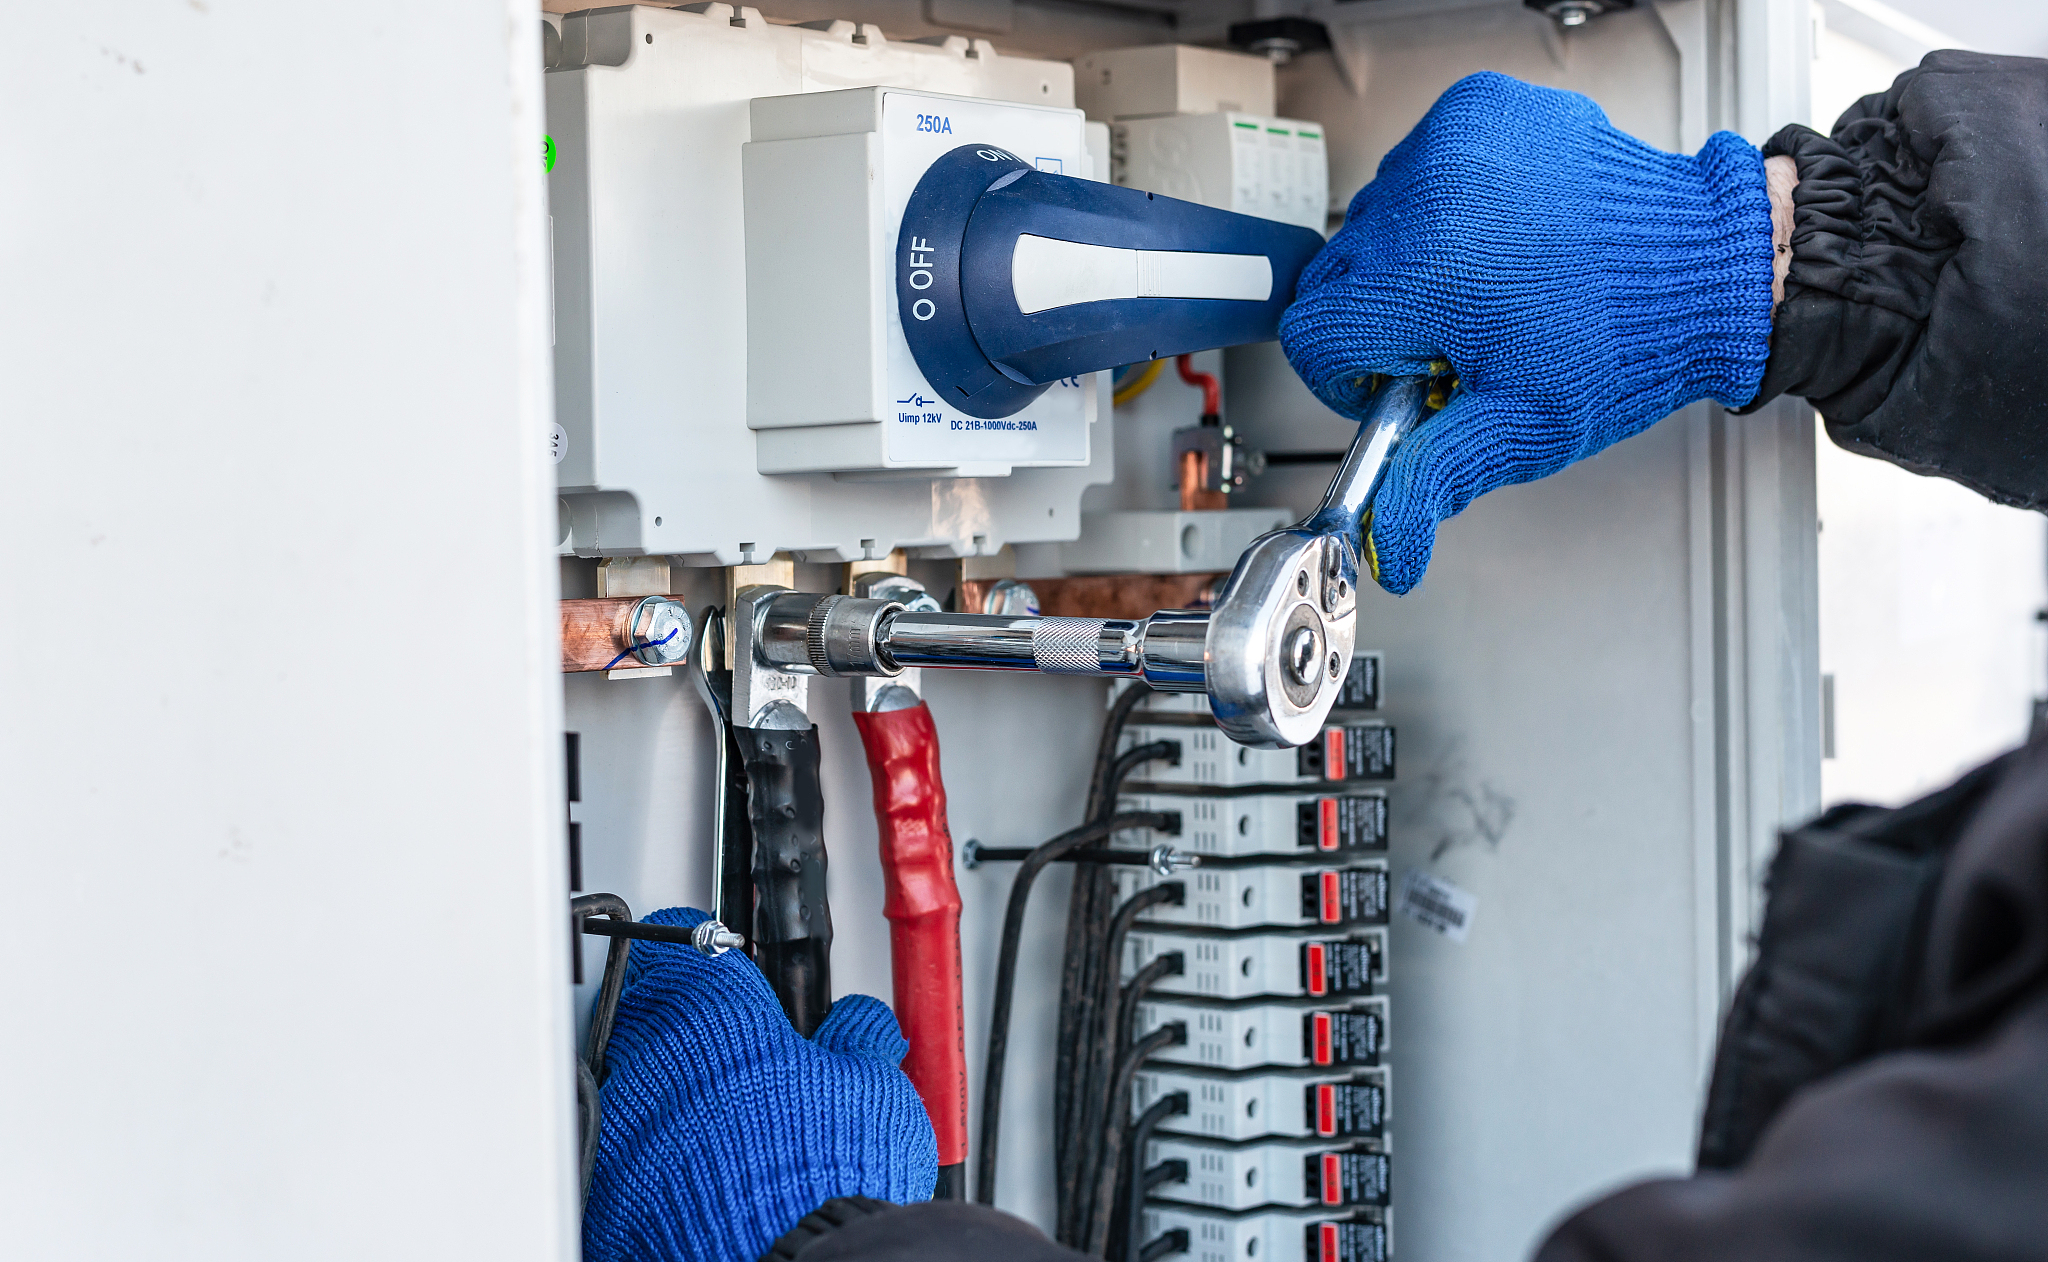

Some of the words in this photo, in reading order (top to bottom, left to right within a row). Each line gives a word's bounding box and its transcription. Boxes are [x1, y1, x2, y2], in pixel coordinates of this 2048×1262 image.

[916, 113, 952, 135] 250A
[976, 149, 1012, 162] ON
[909, 236, 935, 290] OFF
[898, 413, 920, 425] Uimp
[922, 413, 942, 424] 12kV
[951, 420, 963, 430] DC
[965, 420, 1037, 431] 21B-1000Vdc-250A
